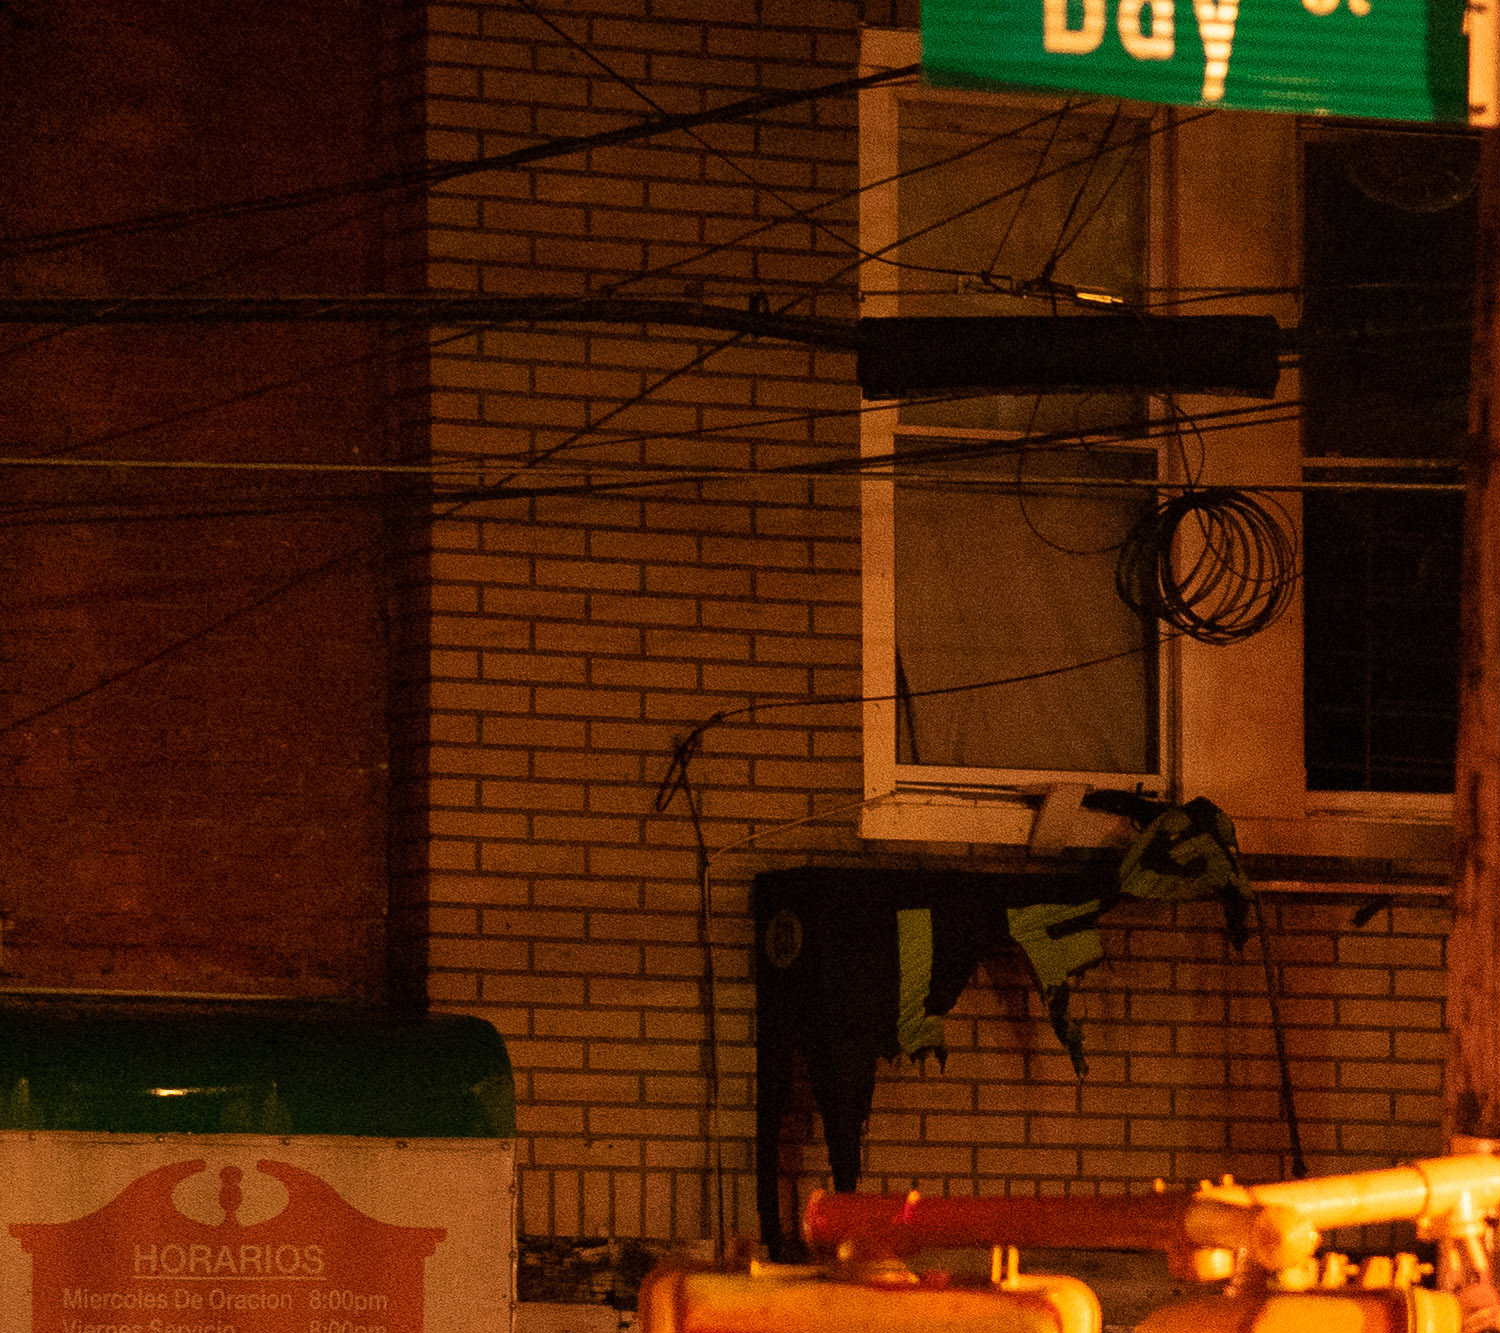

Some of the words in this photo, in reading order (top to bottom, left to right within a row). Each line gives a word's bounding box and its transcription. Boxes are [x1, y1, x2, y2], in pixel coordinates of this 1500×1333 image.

[133, 1244, 325, 1275] HORARIOS
[173, 1287, 208, 1311] De
[308, 1288, 389, 1316] 8:00pm
